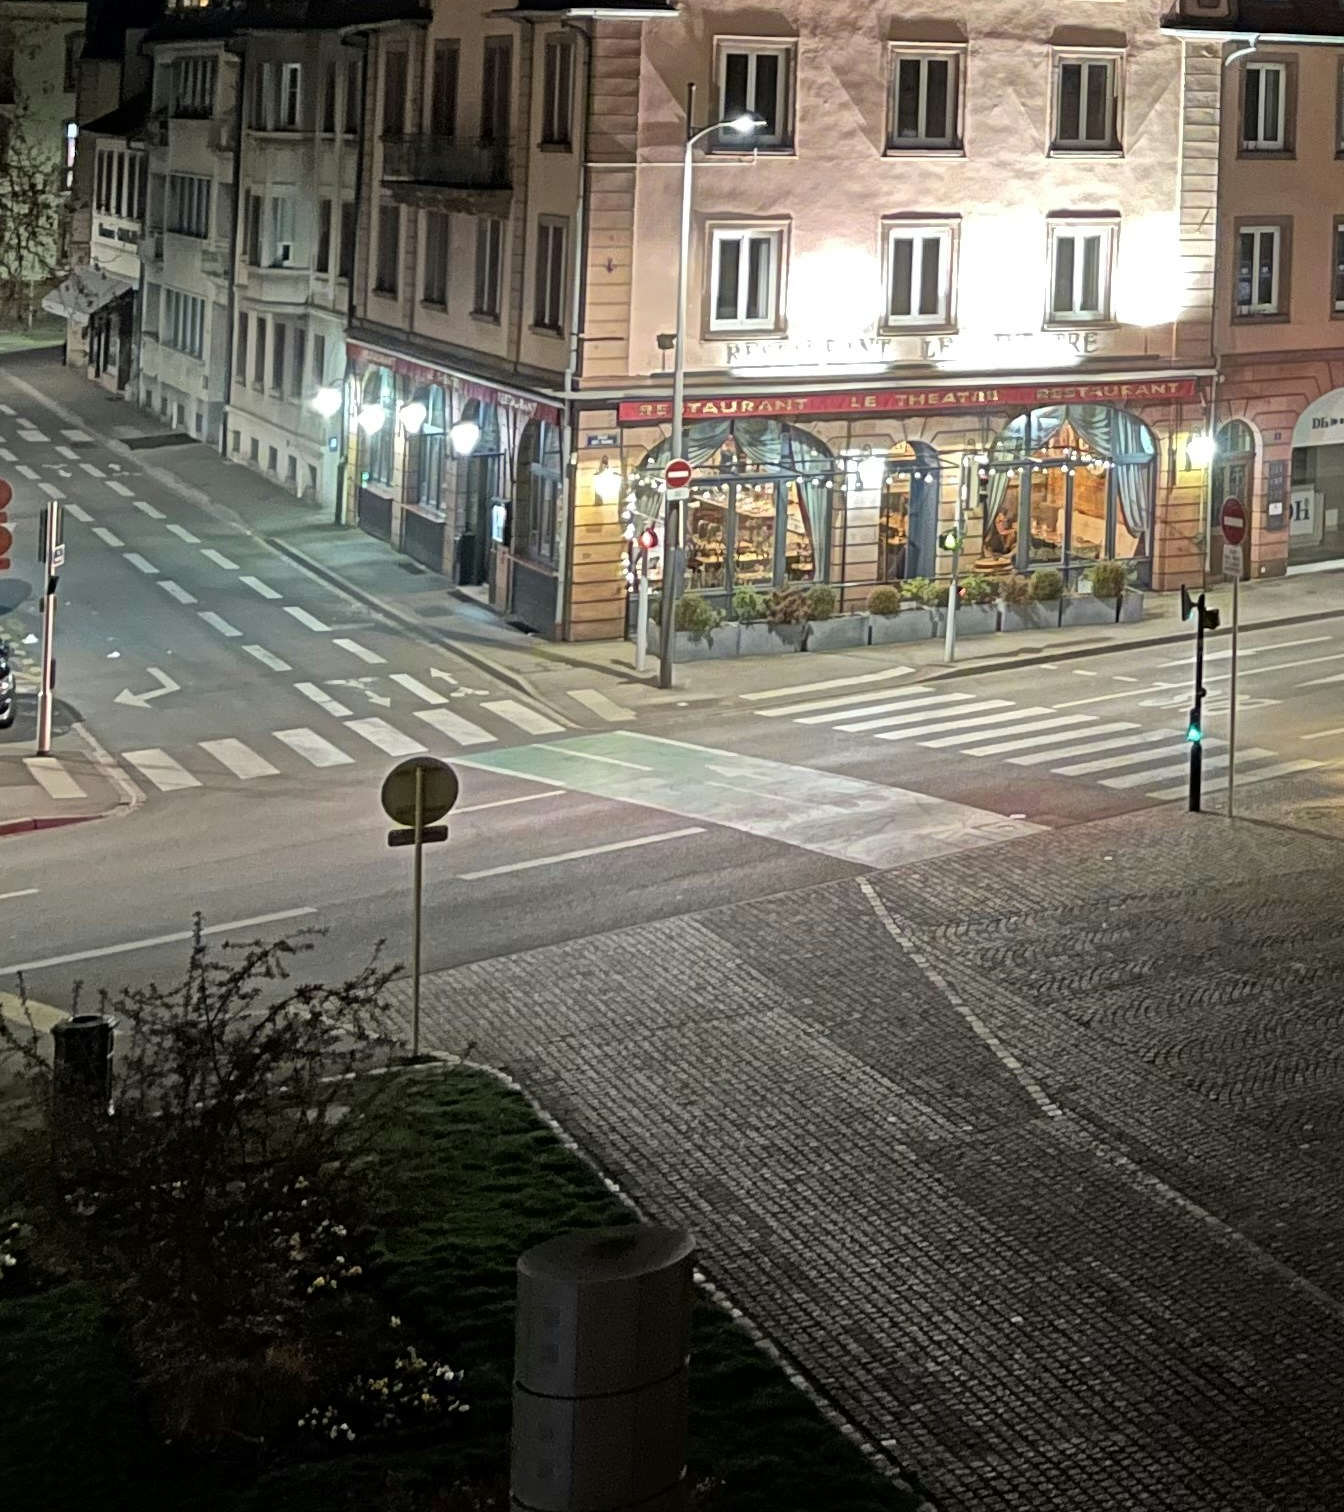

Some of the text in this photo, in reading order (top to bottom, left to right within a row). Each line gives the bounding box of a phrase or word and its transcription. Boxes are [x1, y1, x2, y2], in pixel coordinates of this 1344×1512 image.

[1036, 382, 1179, 401] RESTAURANT
[639, 399, 808, 417] RETAURANT
[851, 395, 877, 408] LE
